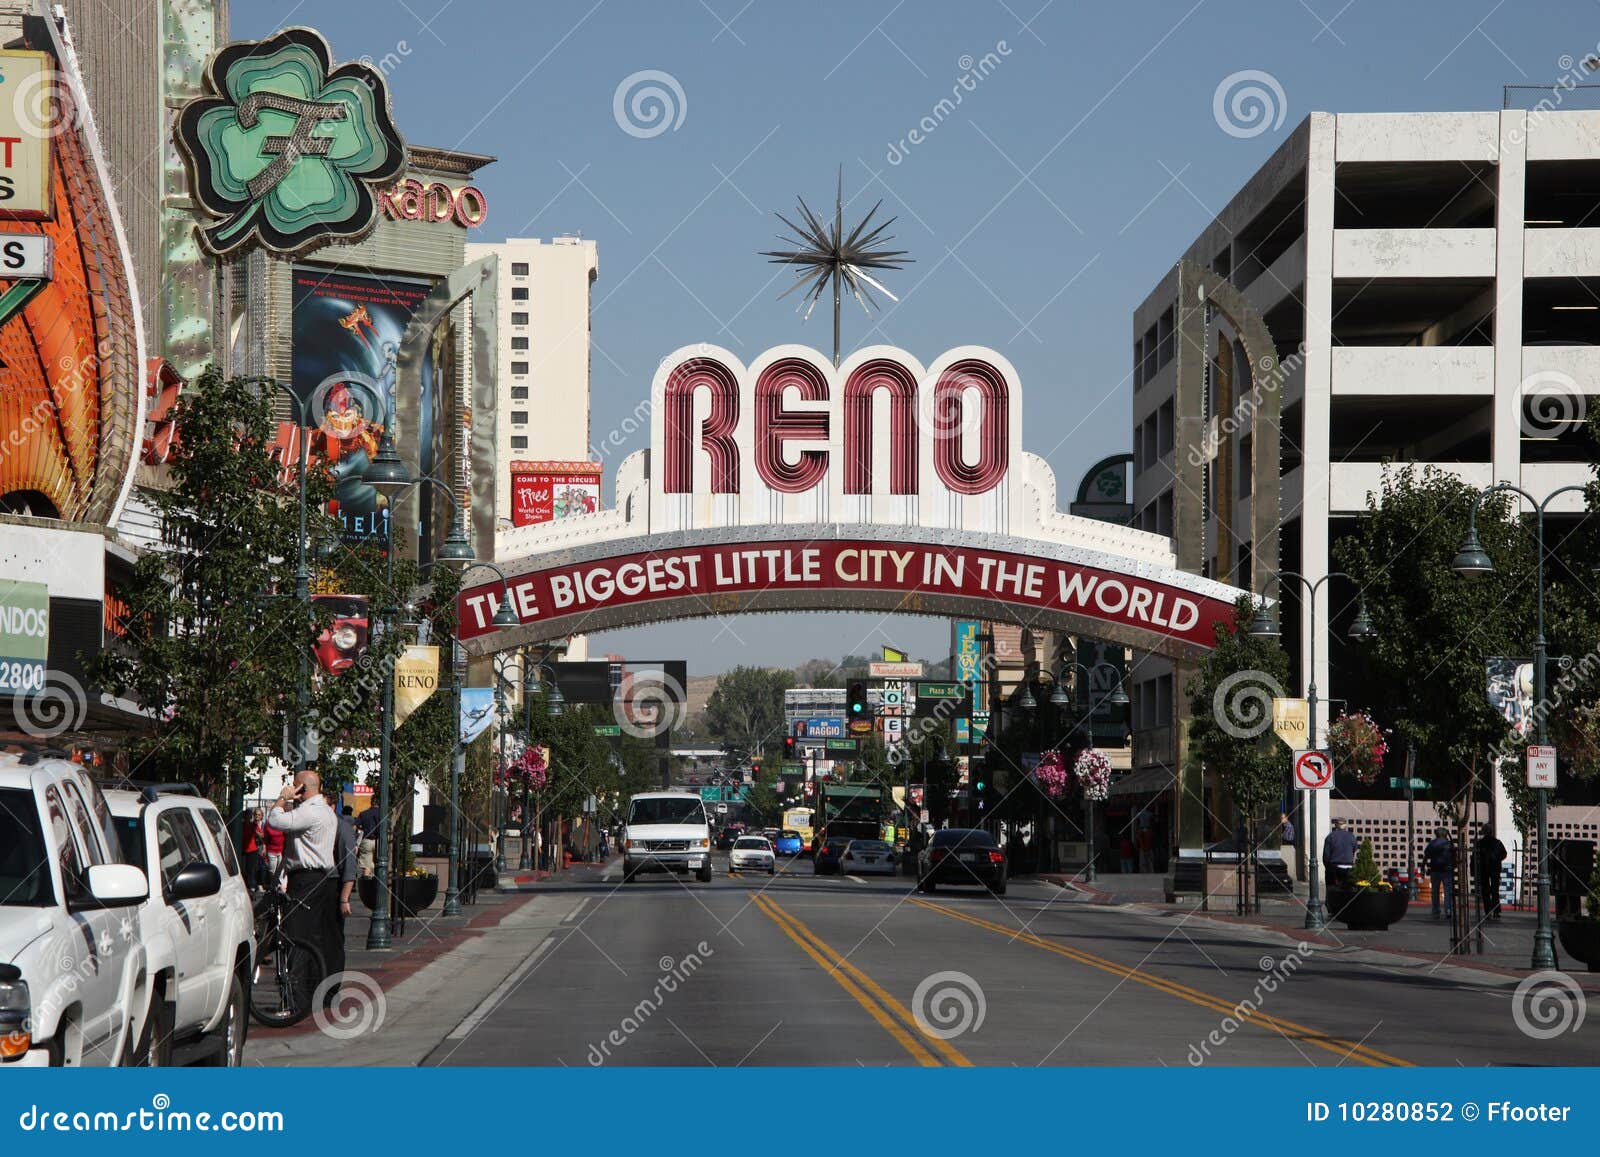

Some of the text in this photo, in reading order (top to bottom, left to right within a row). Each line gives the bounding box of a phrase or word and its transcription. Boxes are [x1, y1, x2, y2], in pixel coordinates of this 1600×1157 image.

[664, 357, 1010, 495] RENO
[518, 488, 550, 508] Free
[466, 549, 1200, 632] THE BIGGEST LITTLE CITY IN THE WORLD
[398, 676, 435, 688] RENO
[886, 681, 900, 741] MOTEL
[810, 726, 840, 736] RAGGIO
[1277, 720, 1305, 731] RENO
[1536, 773, 1548, 781] TIME
